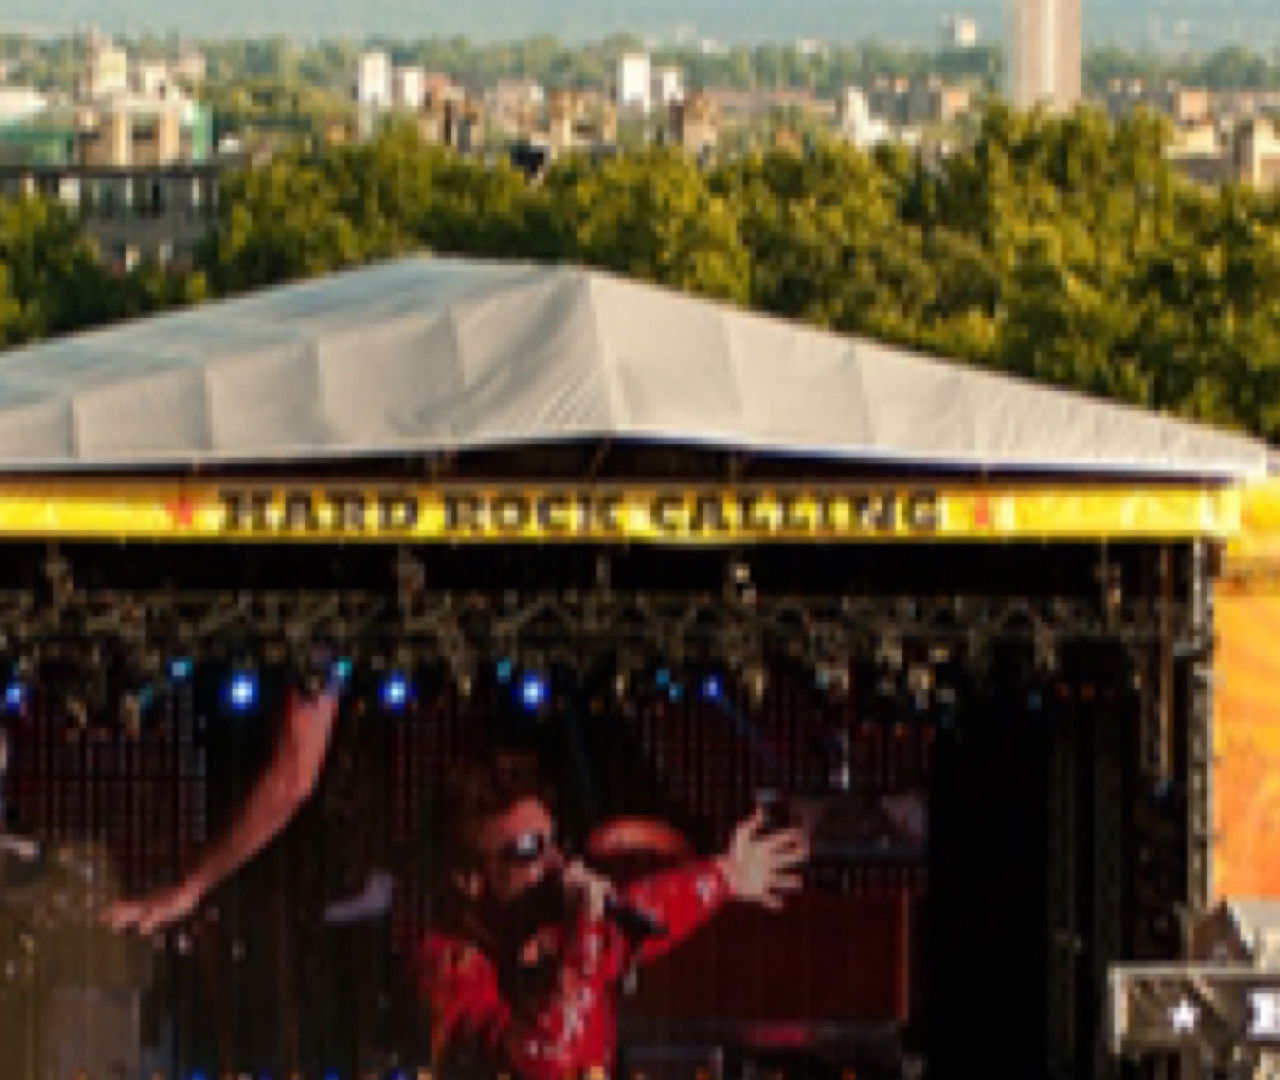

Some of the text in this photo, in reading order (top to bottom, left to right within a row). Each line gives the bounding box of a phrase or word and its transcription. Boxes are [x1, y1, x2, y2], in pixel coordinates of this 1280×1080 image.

[218, 486, 941, 533] HARD ROCK CALLING
